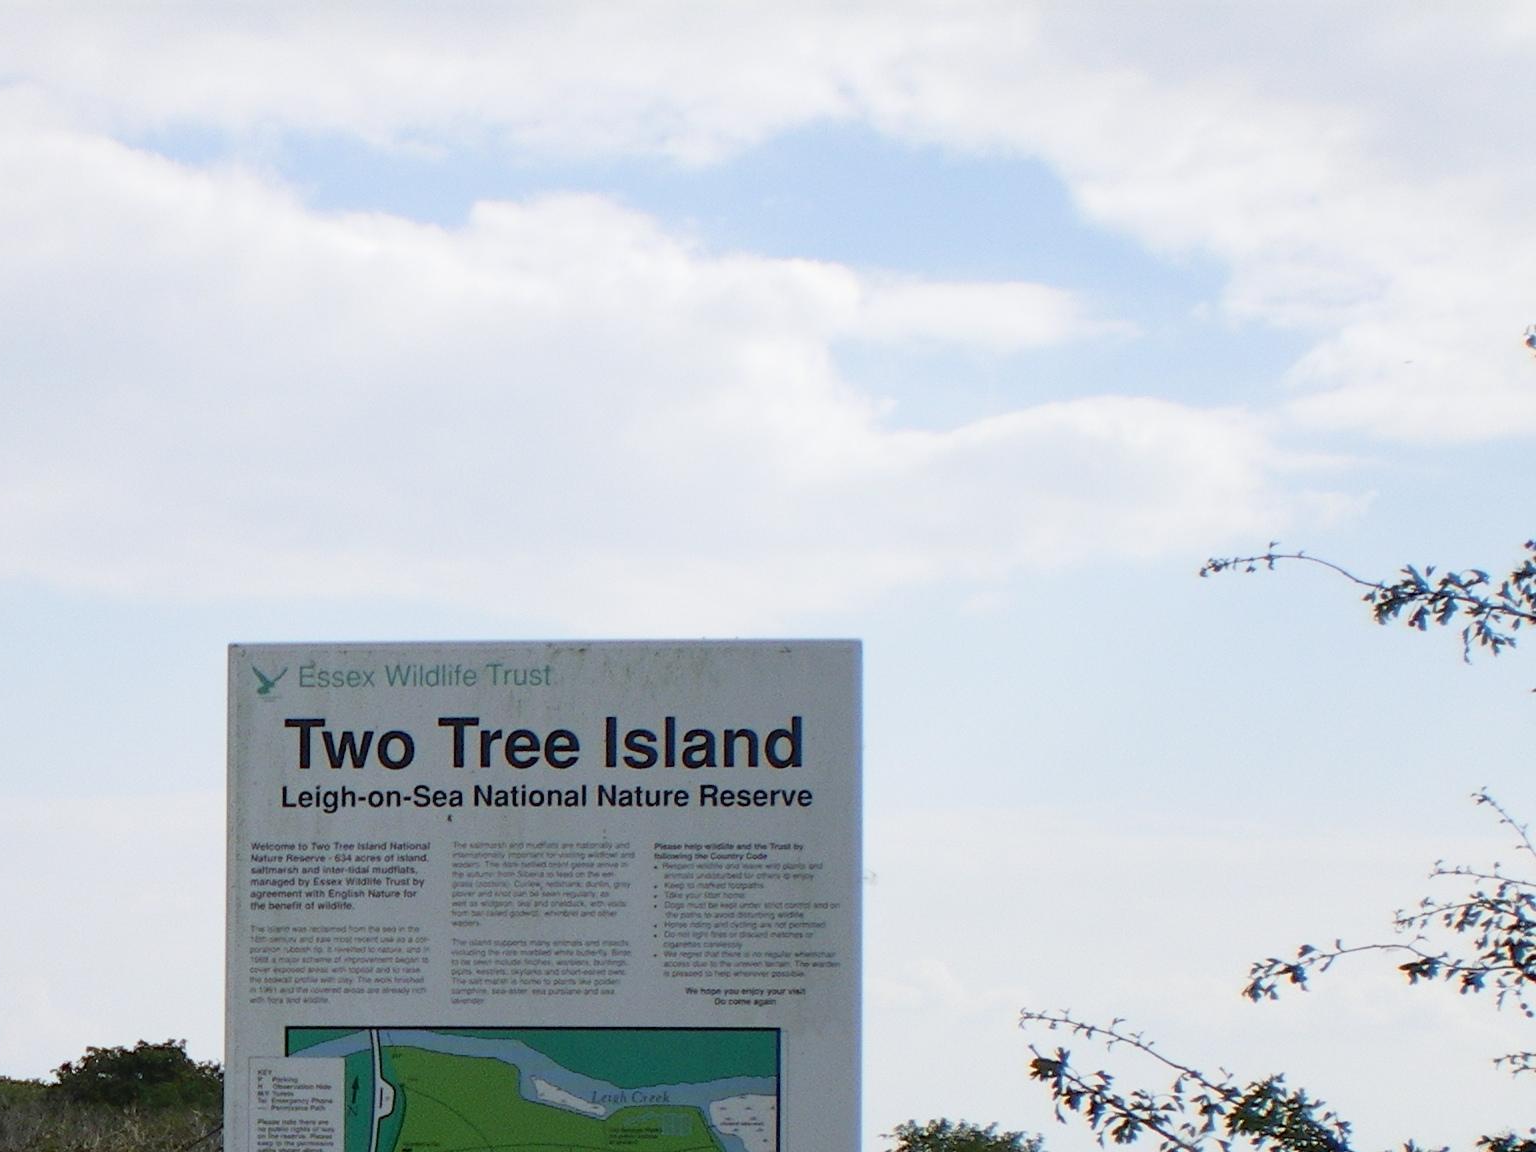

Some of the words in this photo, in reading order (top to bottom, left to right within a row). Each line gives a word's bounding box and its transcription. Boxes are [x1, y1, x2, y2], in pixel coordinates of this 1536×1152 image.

[299, 662, 374, 688] Essex
[385, 664, 477, 687] Wildlife
[485, 663, 551, 686] Trust
[285, 718, 414, 770] Two
[438, 717, 579, 769] Tree
[605, 716, 802, 769] Island
[282, 785, 462, 812] Leigh-on-Sea
[474, 784, 586, 807] National
[598, 784, 689, 807] Nature
[700, 784, 812, 807] Reserve
[251, 842, 295, 851] Welcome
[298, 843, 308, 851] to
[311, 841, 330, 851] Two
[334, 841, 354, 850] Tree
[357, 842, 386, 850] Island
[389, 842, 430, 850] National
[251, 854, 283, 862] Nature
[286, 853, 326, 862] Reserve
[334, 853, 352, 862] 634
[384, 854, 394, 862] of
[251, 866, 298, 874] saltmarsh
[301, 866, 320, 874] and
[322, 865, 369, 874] inter-tidal
[250, 877, 295, 888] managed
[298, 878, 310, 887] by
[313, 877, 342, 886] Essex
[345, 877, 382, 886] Wildlife
[385, 877, 410, 885] Trust
[412, 878, 424, 887] by
[250, 890, 302, 900] agreement
[305, 889, 325, 897] with
[328, 889, 364, 900] English
[368, 889, 400, 898] Nature
[403, 889, 416, 898] for
[250, 901, 265, 910] the
[268, 901, 302, 910] benefit
[304, 901, 314, 909] of
